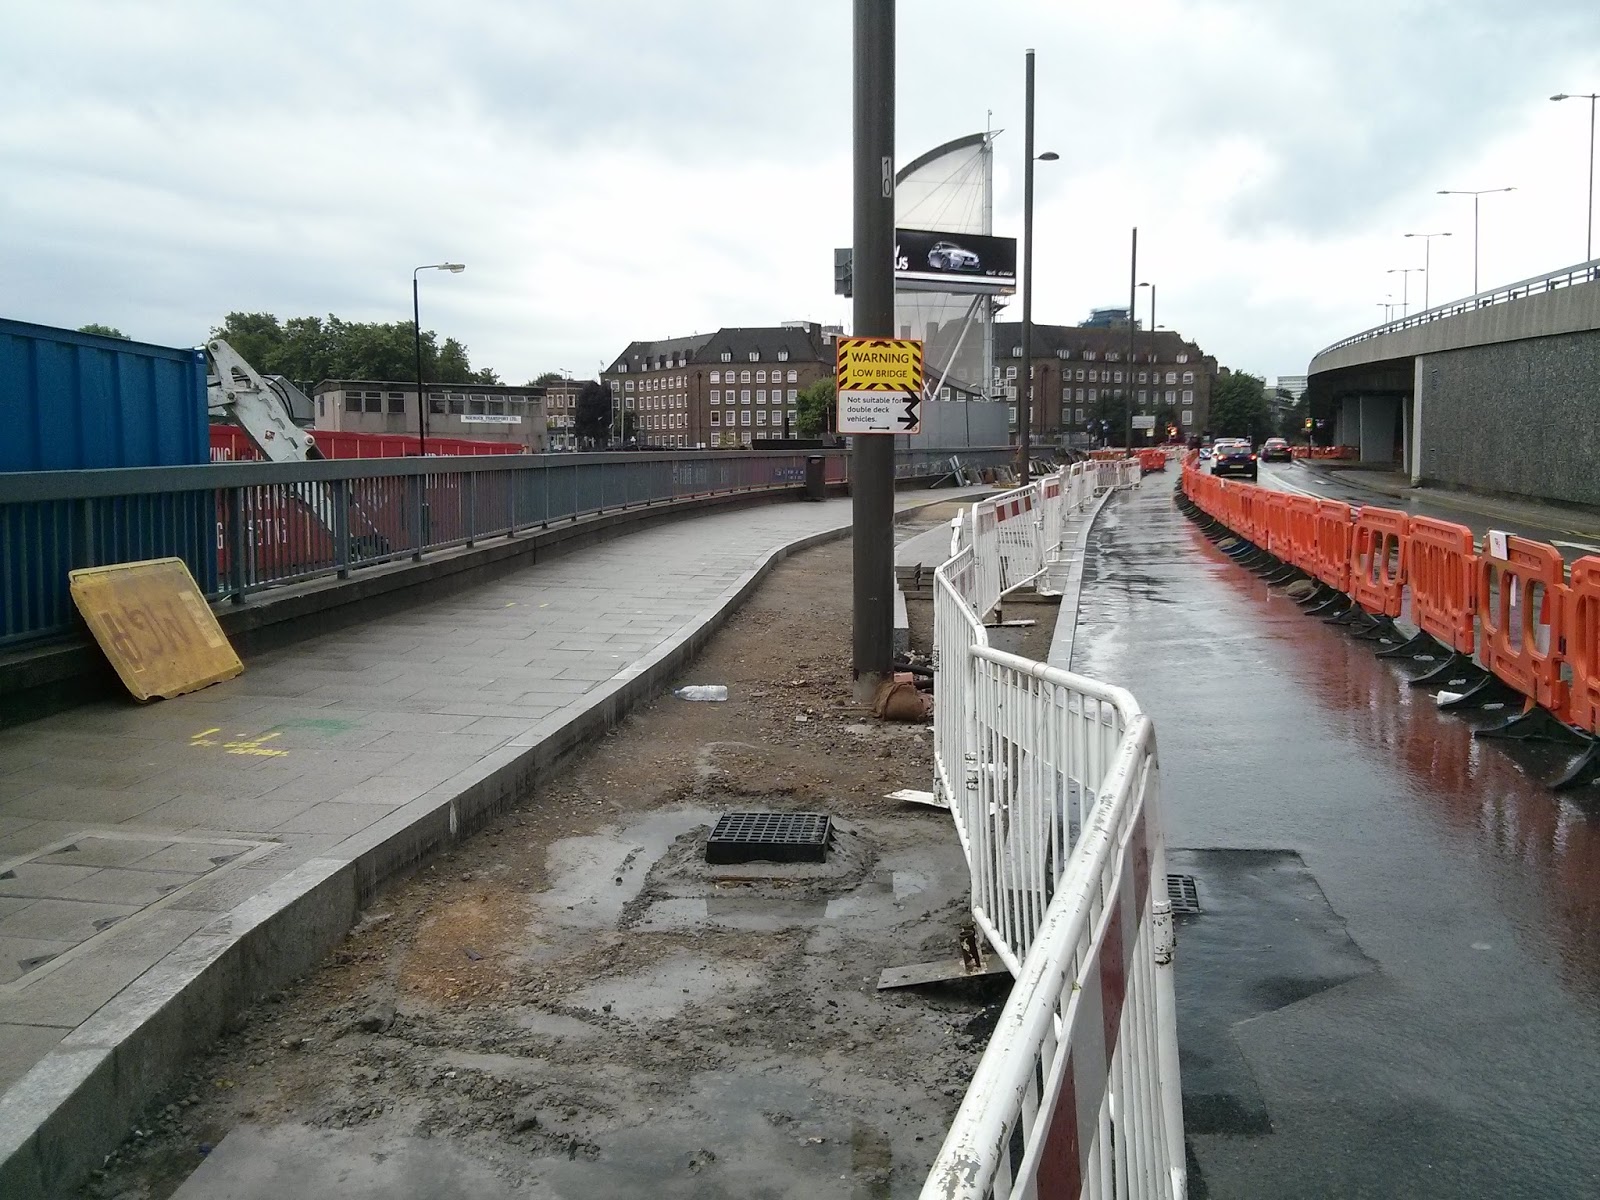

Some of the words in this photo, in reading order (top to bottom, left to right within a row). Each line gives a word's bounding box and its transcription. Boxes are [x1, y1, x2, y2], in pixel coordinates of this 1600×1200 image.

[852, 353, 909, 364] WARNING
[876, 370, 908, 378] BRIDGE
[847, 396, 861, 404] Not
[862, 396, 890, 404] suitable
